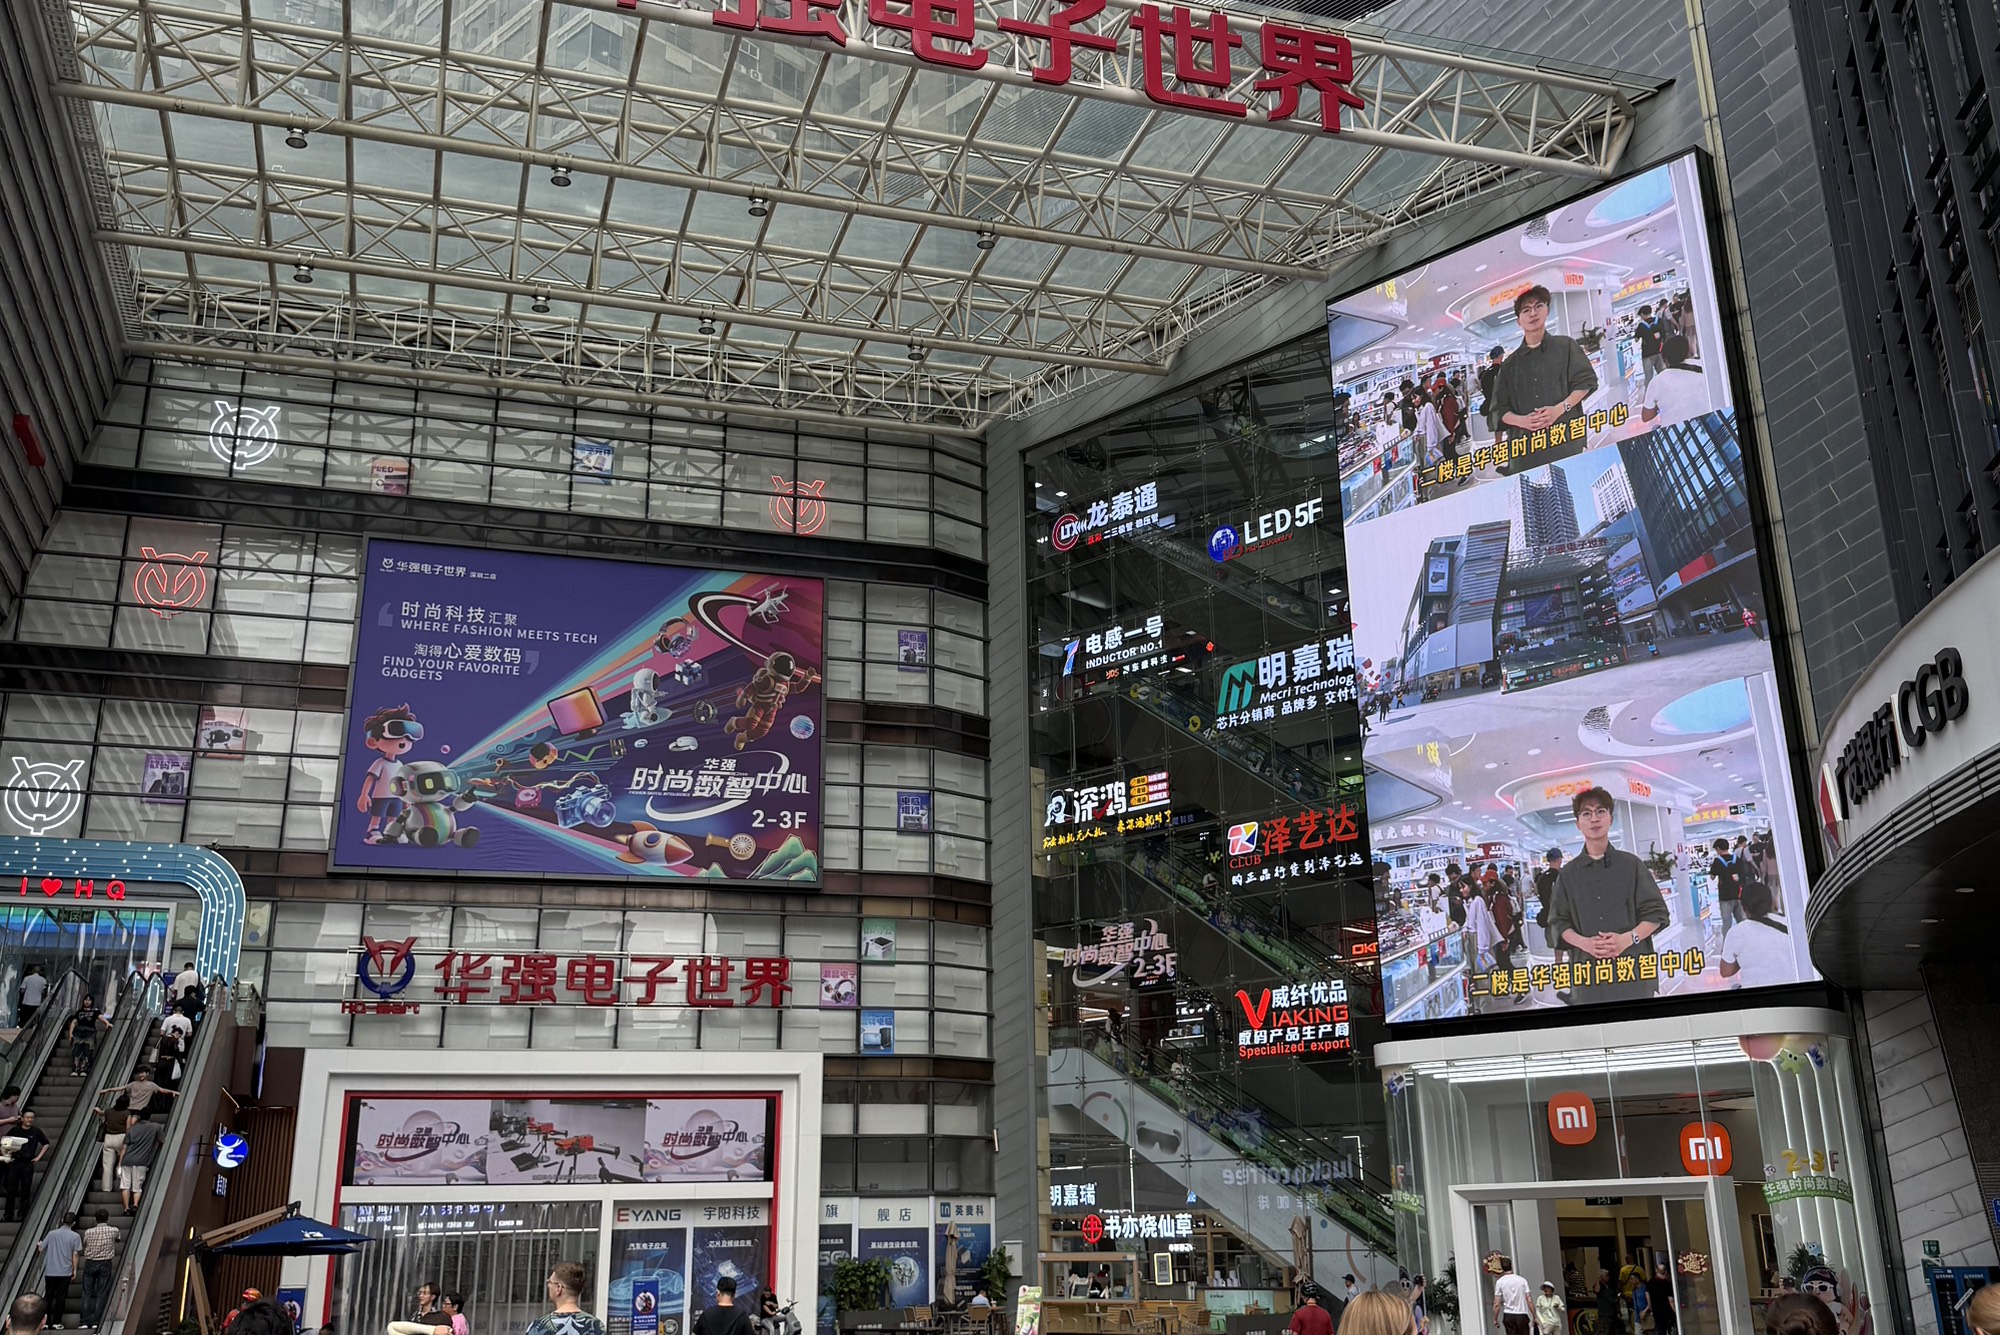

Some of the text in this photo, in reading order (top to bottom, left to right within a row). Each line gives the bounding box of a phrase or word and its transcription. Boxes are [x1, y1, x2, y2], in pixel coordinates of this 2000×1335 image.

[617, 0, 1364, 134] 电子世界
[1421, 402, 1628, 487] 二楼是华强时尚数智中心
[1087, 481, 1158, 530] 龙泰通
[1061, 521, 1078, 540] LTX
[1244, 497, 1322, 544] LED 5F
[396, 560, 467, 577] 华强电子世界
[401, 600, 518, 626] 时尚科技汇聚
[401, 618, 598, 645] WHERE FASHION MEETS TECH
[1085, 615, 1164, 655] 电感一号
[383, 655, 520, 676] FIND YOUR FAVORITE
[413, 643, 522, 665] 淘得心爱数码
[1086, 639, 1163, 669] INDUCTOR NO.1
[1258, 634, 1355, 689] 明嘉瑞
[382, 667, 443, 681] GADGETS
[1259, 687, 1292, 704] Mecri
[1897, 647, 1969, 748] CGB
[1217, 704, 1275, 730] 芯片分销商
[1281, 695, 1318, 716] 品牌多
[703, 758, 737, 771] 华强
[625, 763, 811, 800] 时尚数智中心
[752, 810, 807, 829] 2-3F
[1261, 803, 1359, 857] 泽艺达
[1229, 854, 1262, 870] CLUB
[1231, 852, 1364, 886] 购正品行货到泽艺达
[20, 876, 29, 897] I
[1101, 921, 1135, 943] 华强
[1063, 929, 1171, 968] 时尚数智中心
[434, 950, 793, 1008] 华强电子世界
[1133, 953, 1178, 979] 2-3F
[1471, 947, 1706, 997] 二楼是华强时尚数智中心
[1271, 979, 1348, 1009] 威纤优品
[1238, 1022, 1350, 1046] 数码产品生产商
[1239, 1036, 1350, 1059] Specialized export
[617, 1207, 682, 1222] EYANG
[703, 1206, 760, 1220] 宇阳科技
[825, 1203, 838, 1218] 旗
[955, 1204, 984, 1217] 英麦科
[1104, 1213, 1194, 1240] 书亦烧仙草
